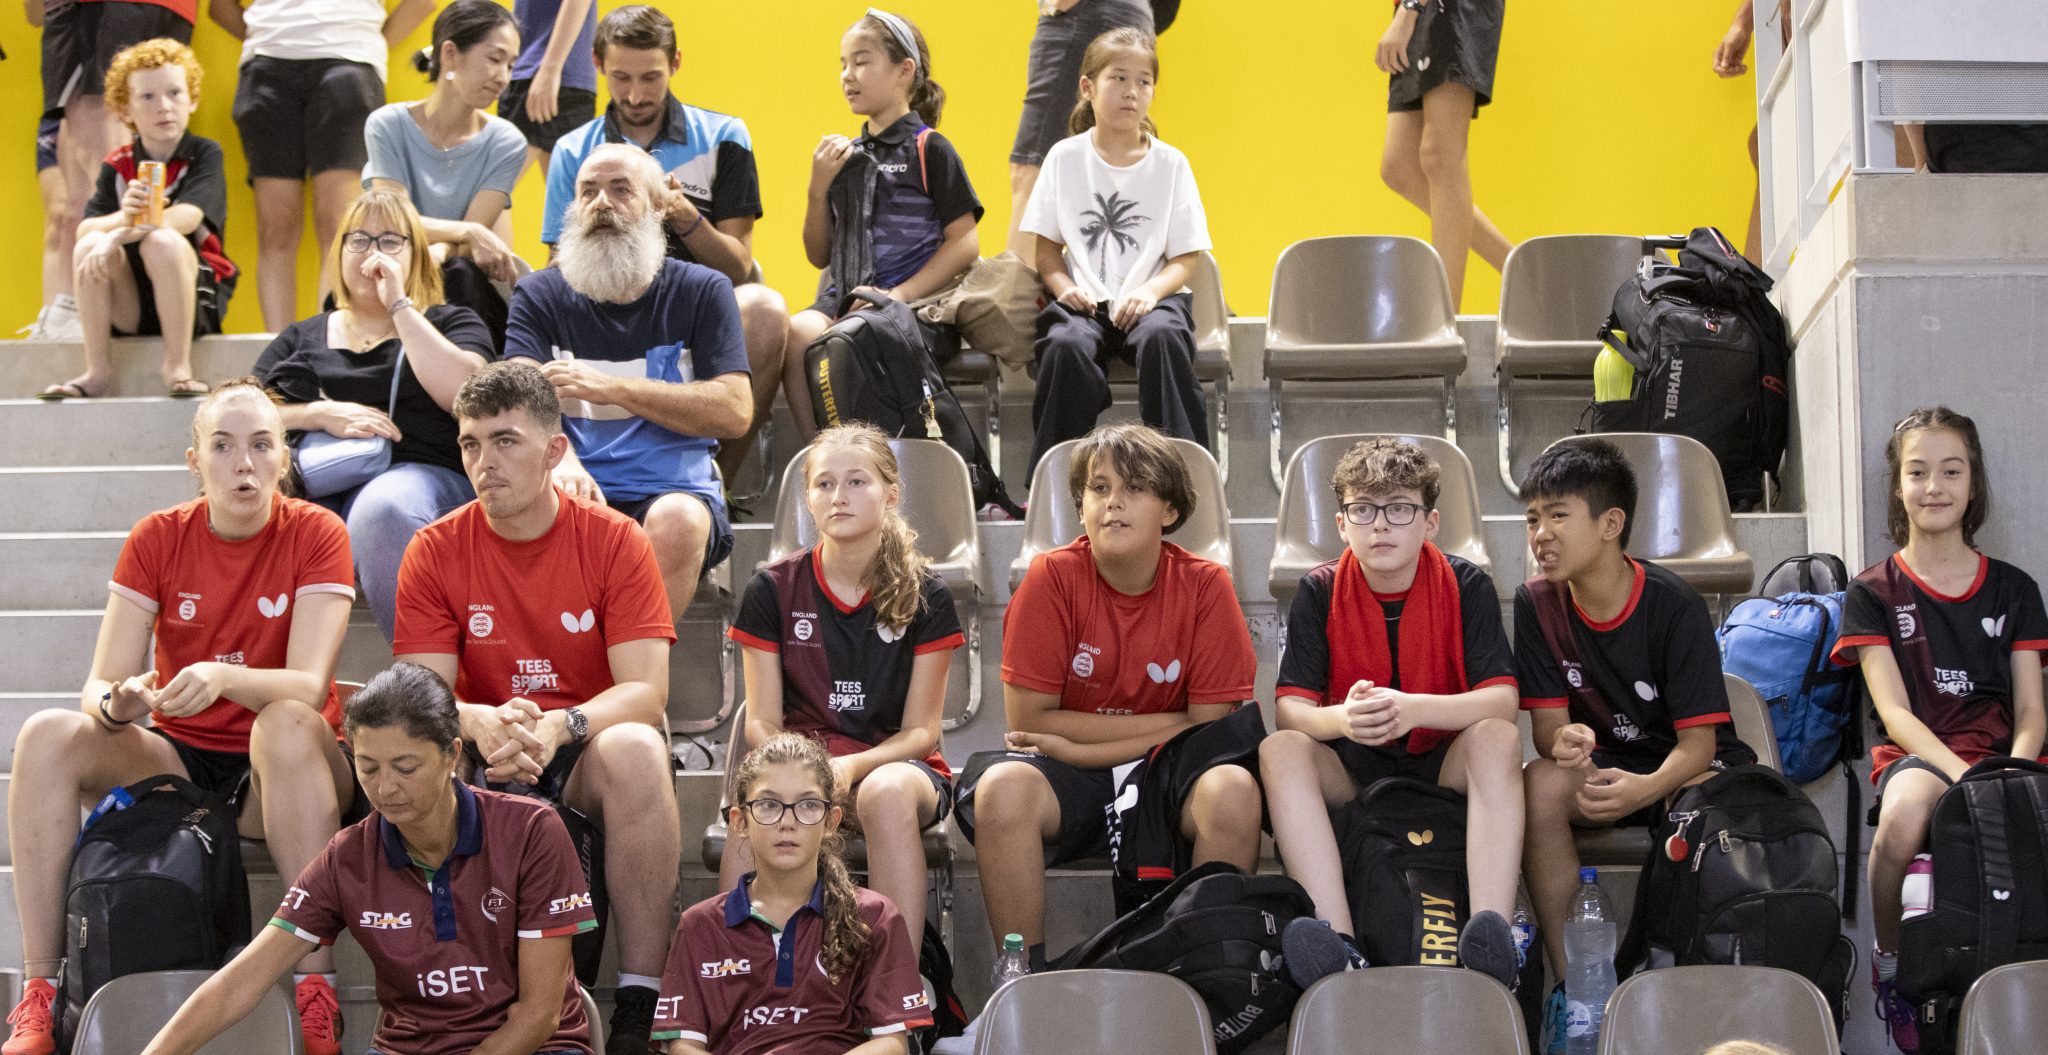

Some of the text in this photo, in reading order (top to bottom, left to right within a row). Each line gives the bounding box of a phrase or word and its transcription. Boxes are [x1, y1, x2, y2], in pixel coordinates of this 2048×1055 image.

[681, 181, 708, 196] ndro
[1664, 359, 1684, 420] TIBHAR
[791, 611, 818, 619] ENGLAND
[1078, 642, 1101, 655] NGLAND
[515, 660, 552, 674] TEES
[1934, 667, 1968, 682] TEES
[834, 681, 862, 694] TEES
[1613, 713, 1631, 726] TE
[280, 886, 311, 910] ET
[359, 911, 413, 929] STAG
[1420, 892, 1458, 967] ERFLY
[700, 958, 751, 978] STAG
[416, 965, 489, 998] iSET
[653, 995, 684, 1020] ET
[743, 1006, 809, 1031] iSET
[1213, 1004, 1265, 1044] BUTTER
